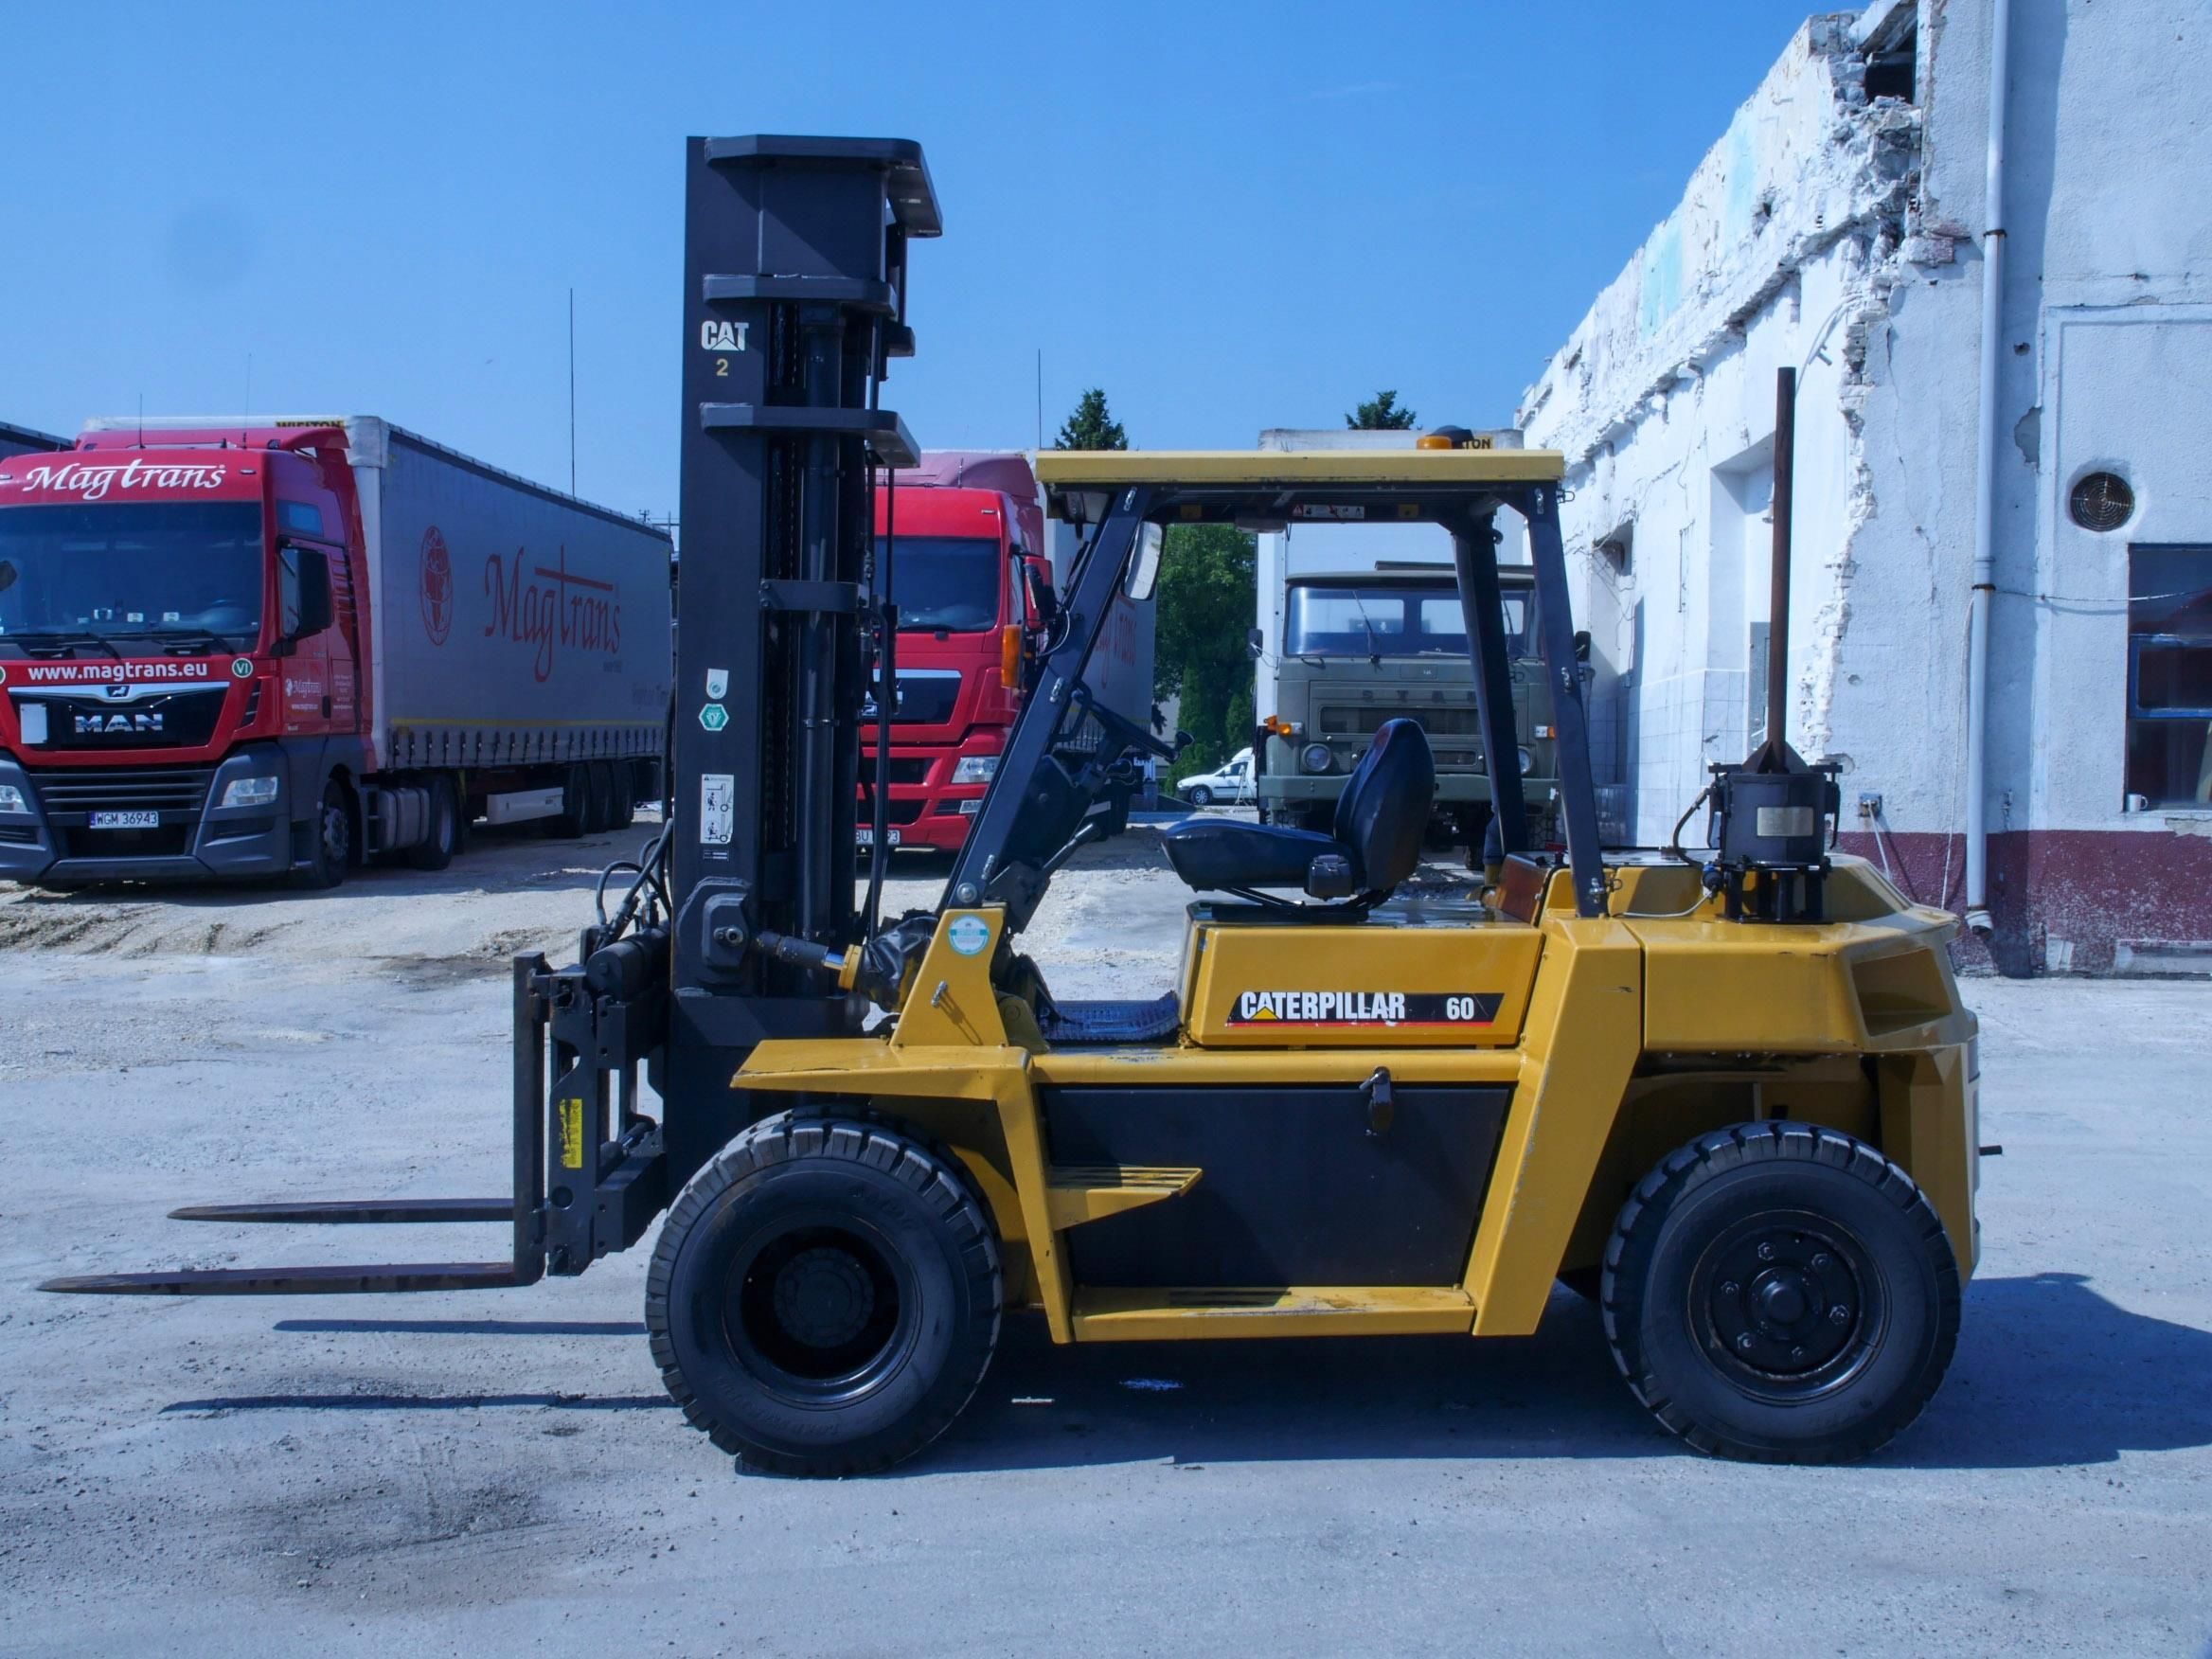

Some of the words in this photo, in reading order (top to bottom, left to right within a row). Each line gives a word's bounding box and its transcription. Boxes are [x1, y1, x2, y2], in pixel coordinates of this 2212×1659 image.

[701, 320, 749, 351] CAT
[716, 358, 728, 377] 2
[23, 459, 227, 500] Magtrans
[485, 544, 620, 683] Magtrans
[27, 662, 207, 682] www.magtrans.eu
[237, 662, 250, 675] VI
[75, 713, 163, 733] MAN
[122, 812, 157, 825] 36943
[1240, 991, 1405, 1020] CATERPILLAR
[1446, 996, 1474, 1021] 60
